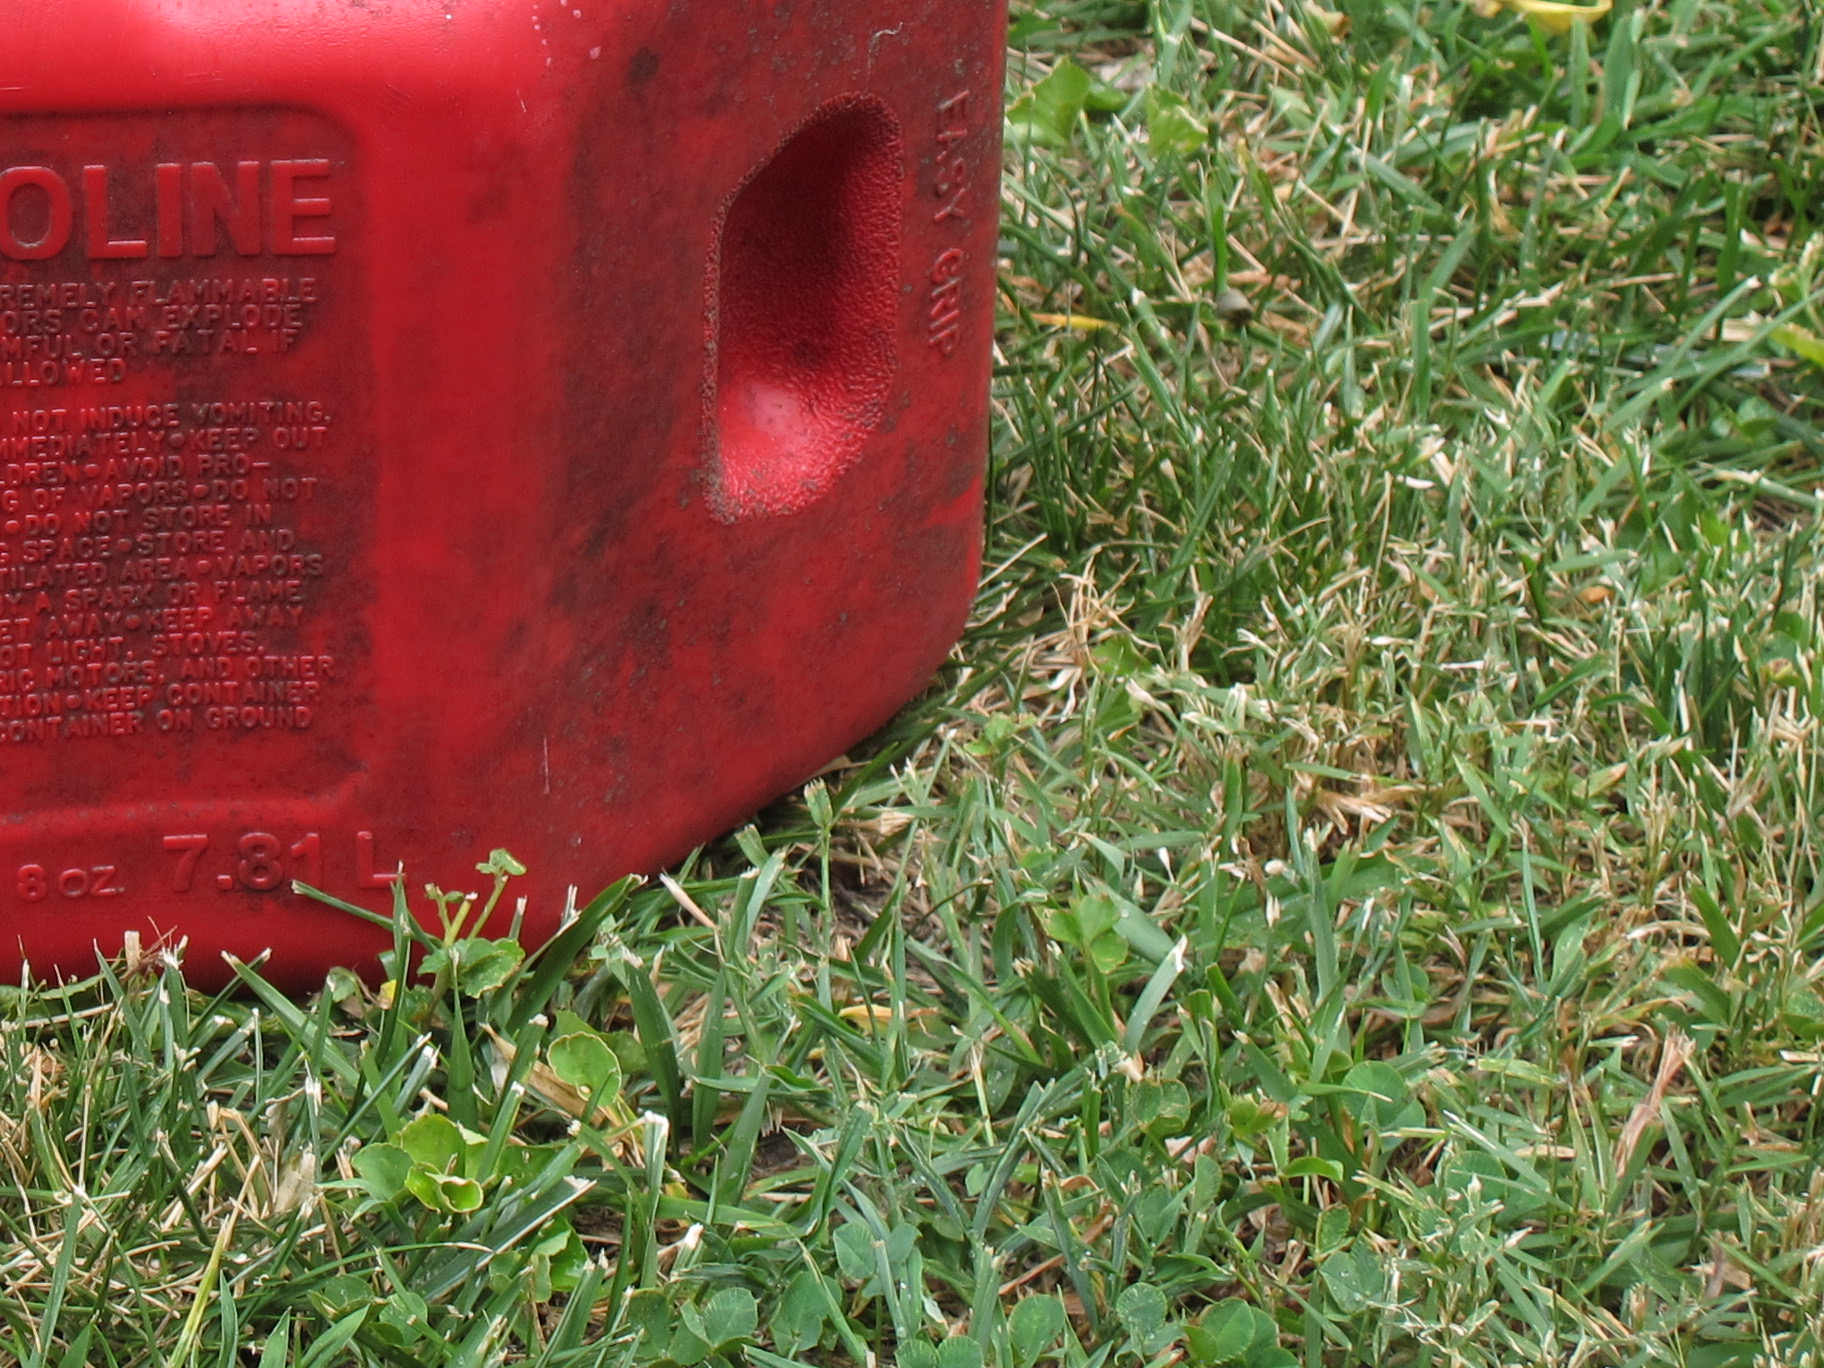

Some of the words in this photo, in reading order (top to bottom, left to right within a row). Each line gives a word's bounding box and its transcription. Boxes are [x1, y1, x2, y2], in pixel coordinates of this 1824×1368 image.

[933, 89, 972, 223] EASY
[132, 277, 317, 306] FLAMMABLE
[928, 247, 965, 358] GRIP
[80, 305, 147, 332] CAN
[162, 303, 304, 330] EXPLODE
[95, 331, 139, 357] OR
[155, 328, 258, 354] FATAL
[12, 409, 68, 433] NOT
[80, 404, 180, 430] INDUCE
[189, 427, 261, 451] KEEP
[273, 425, 328, 449] OUT
[106, 454, 185, 480] AVOID
[197, 452, 272, 477] PRO-
[32, 486, 67, 511] OF
[80, 481, 188, 508] VAPORS
[212, 479, 250, 503] DO
[263, 477, 318, 501] NOT
[25, 512, 61, 535] DO
[75, 509, 129, 532] NOT
[143, 504, 232, 530] STORE
[245, 503, 273, 526] IN
[22, 535, 112, 563] SPACE
[136, 530, 227, 556] STORE
[239, 528, 296, 552] AND
[119, 557, 191, 582] AREA
[213, 553, 324, 579] VAPORS
[35, 590, 52, 614] A
[64, 584, 155, 611] SPARK
[166, 581, 200, 605] OR
[214, 580, 303, 604] FLAME
[45, 611, 122, 638] AWAY
[147, 606, 214, 631] KEEP
[227, 605, 304, 629] AWAY
[179, 656, 235, 680] AND
[244, 654, 334, 679] OTHER
[84, 685, 154, 712] KEEP
[166, 680, 320, 707] CONTAINER
[155, 708, 194, 732] ON
[204, 705, 313, 730] GROUND
[16, 862, 49, 904] 8
[161, 831, 325, 894] 7.81
[354, 830, 408, 890] L
